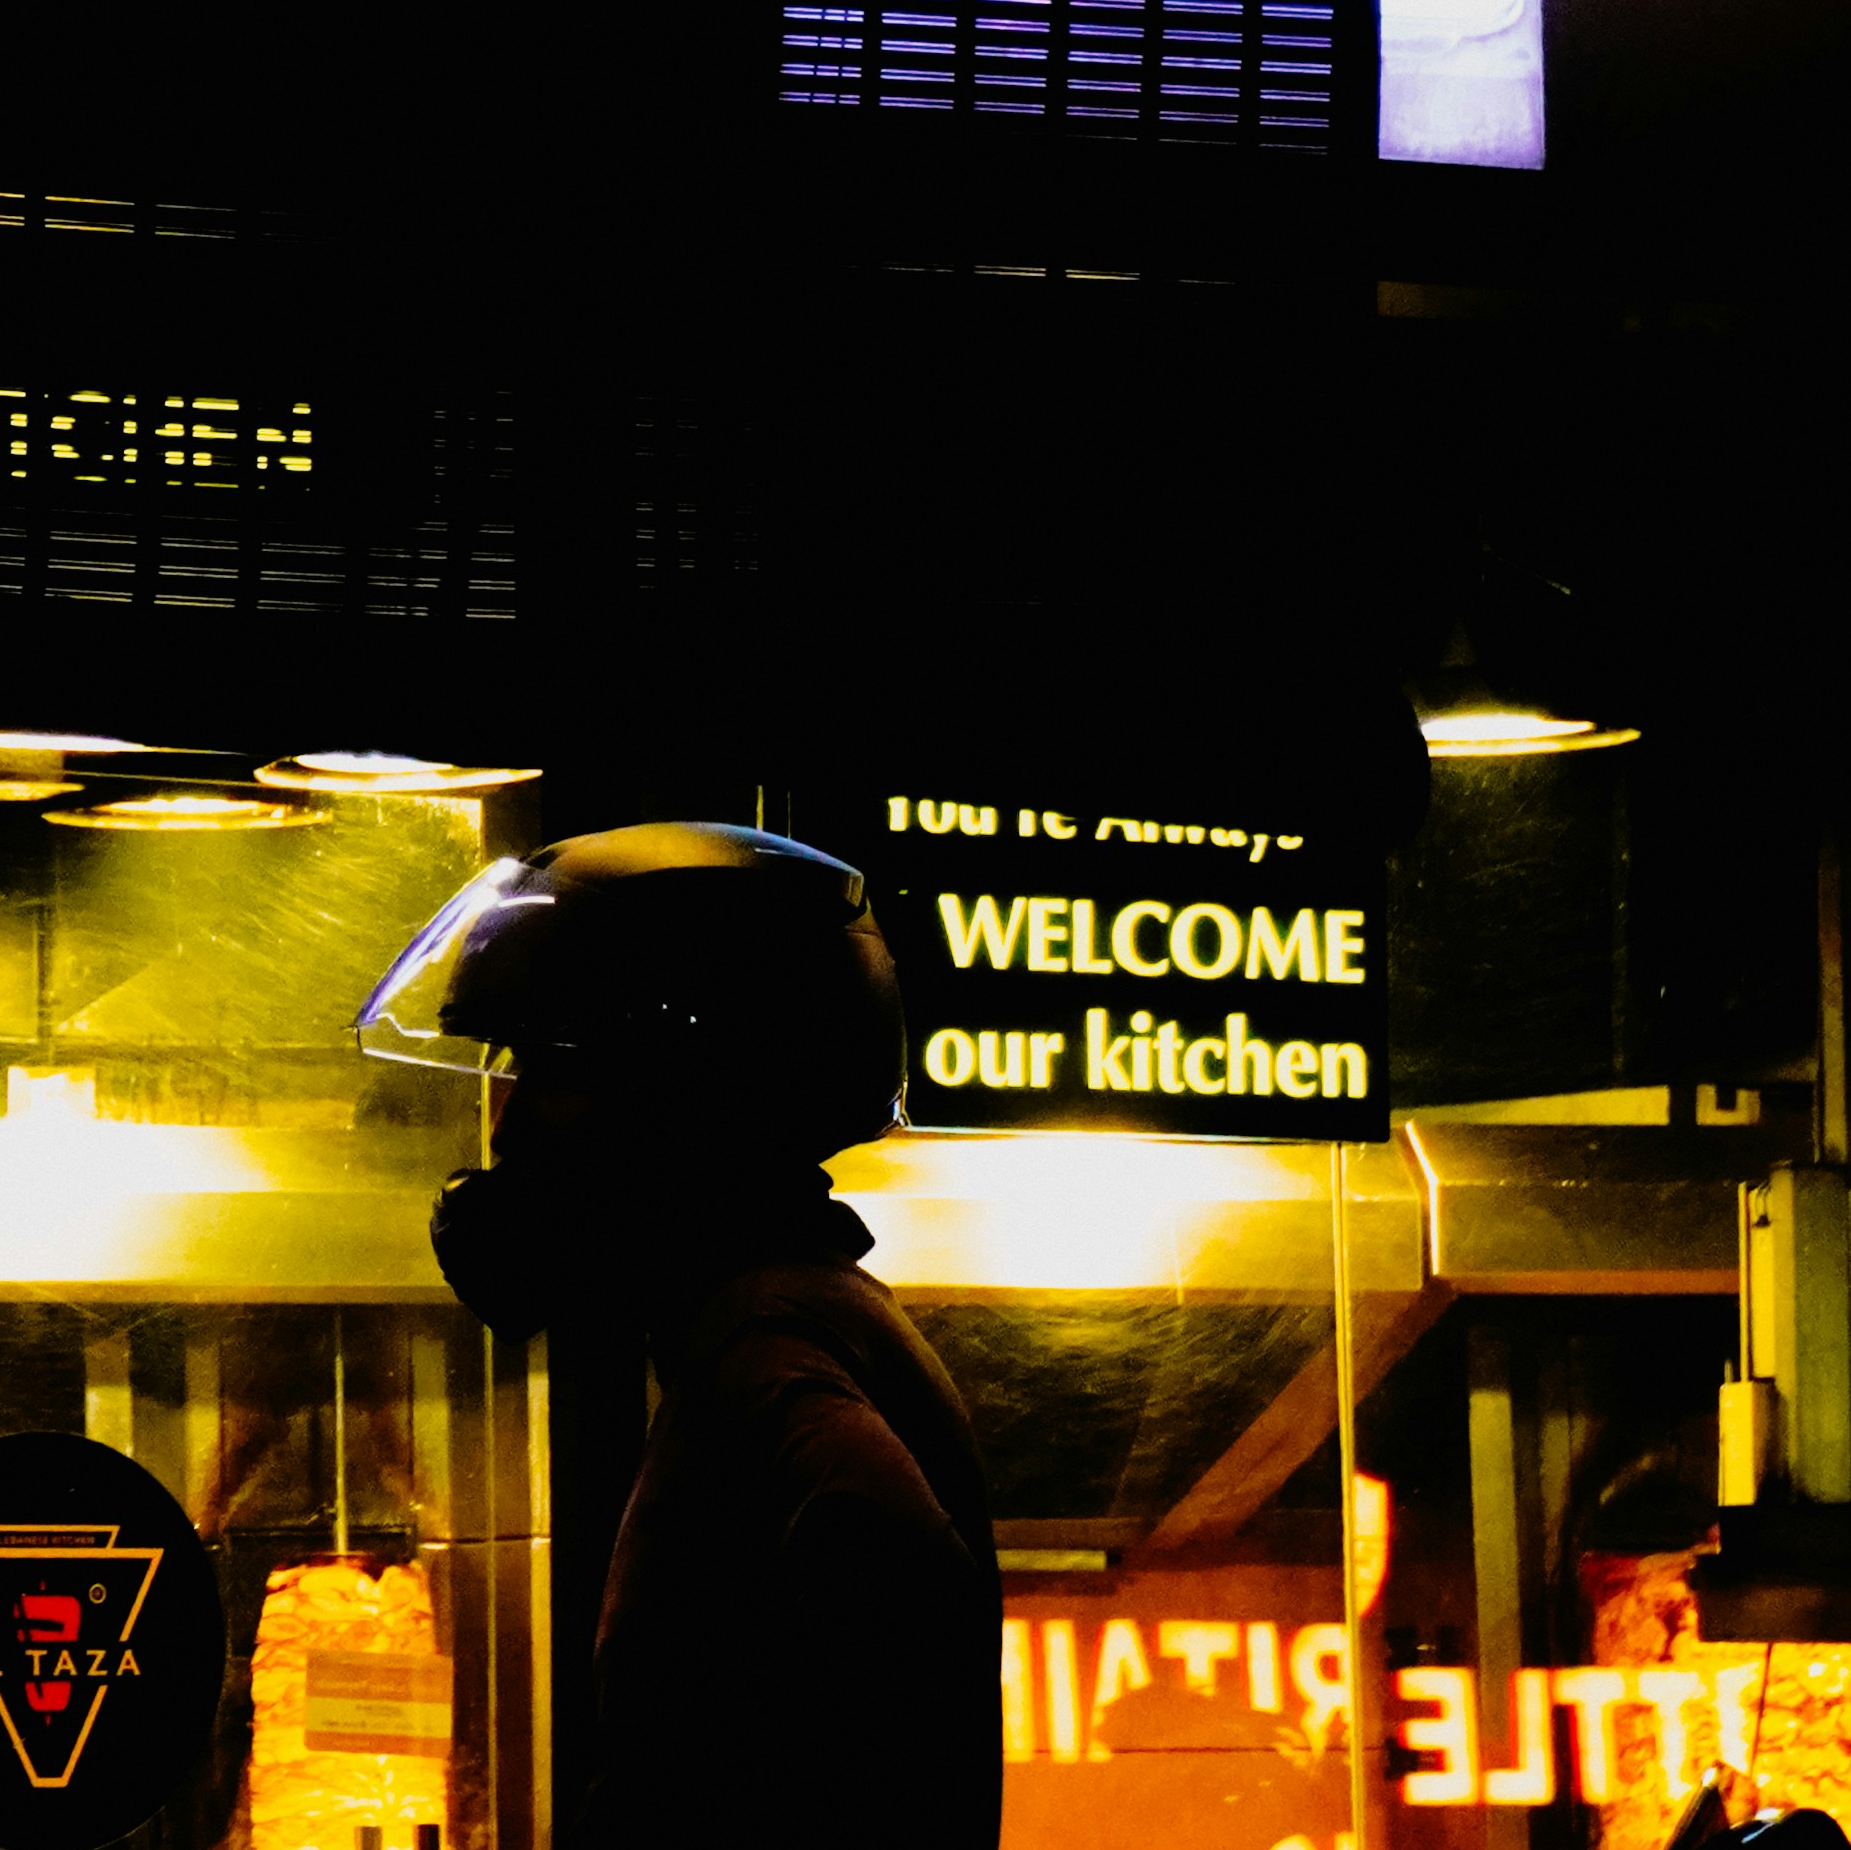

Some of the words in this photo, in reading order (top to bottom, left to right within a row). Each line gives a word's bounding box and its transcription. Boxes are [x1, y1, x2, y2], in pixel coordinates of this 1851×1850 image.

[937, 892, 1366, 985] WELCOME
[923, 1027, 1066, 1090] our
[1084, 1007, 1368, 1099] kitchen
[25, 1649, 141, 1676] TAZA
